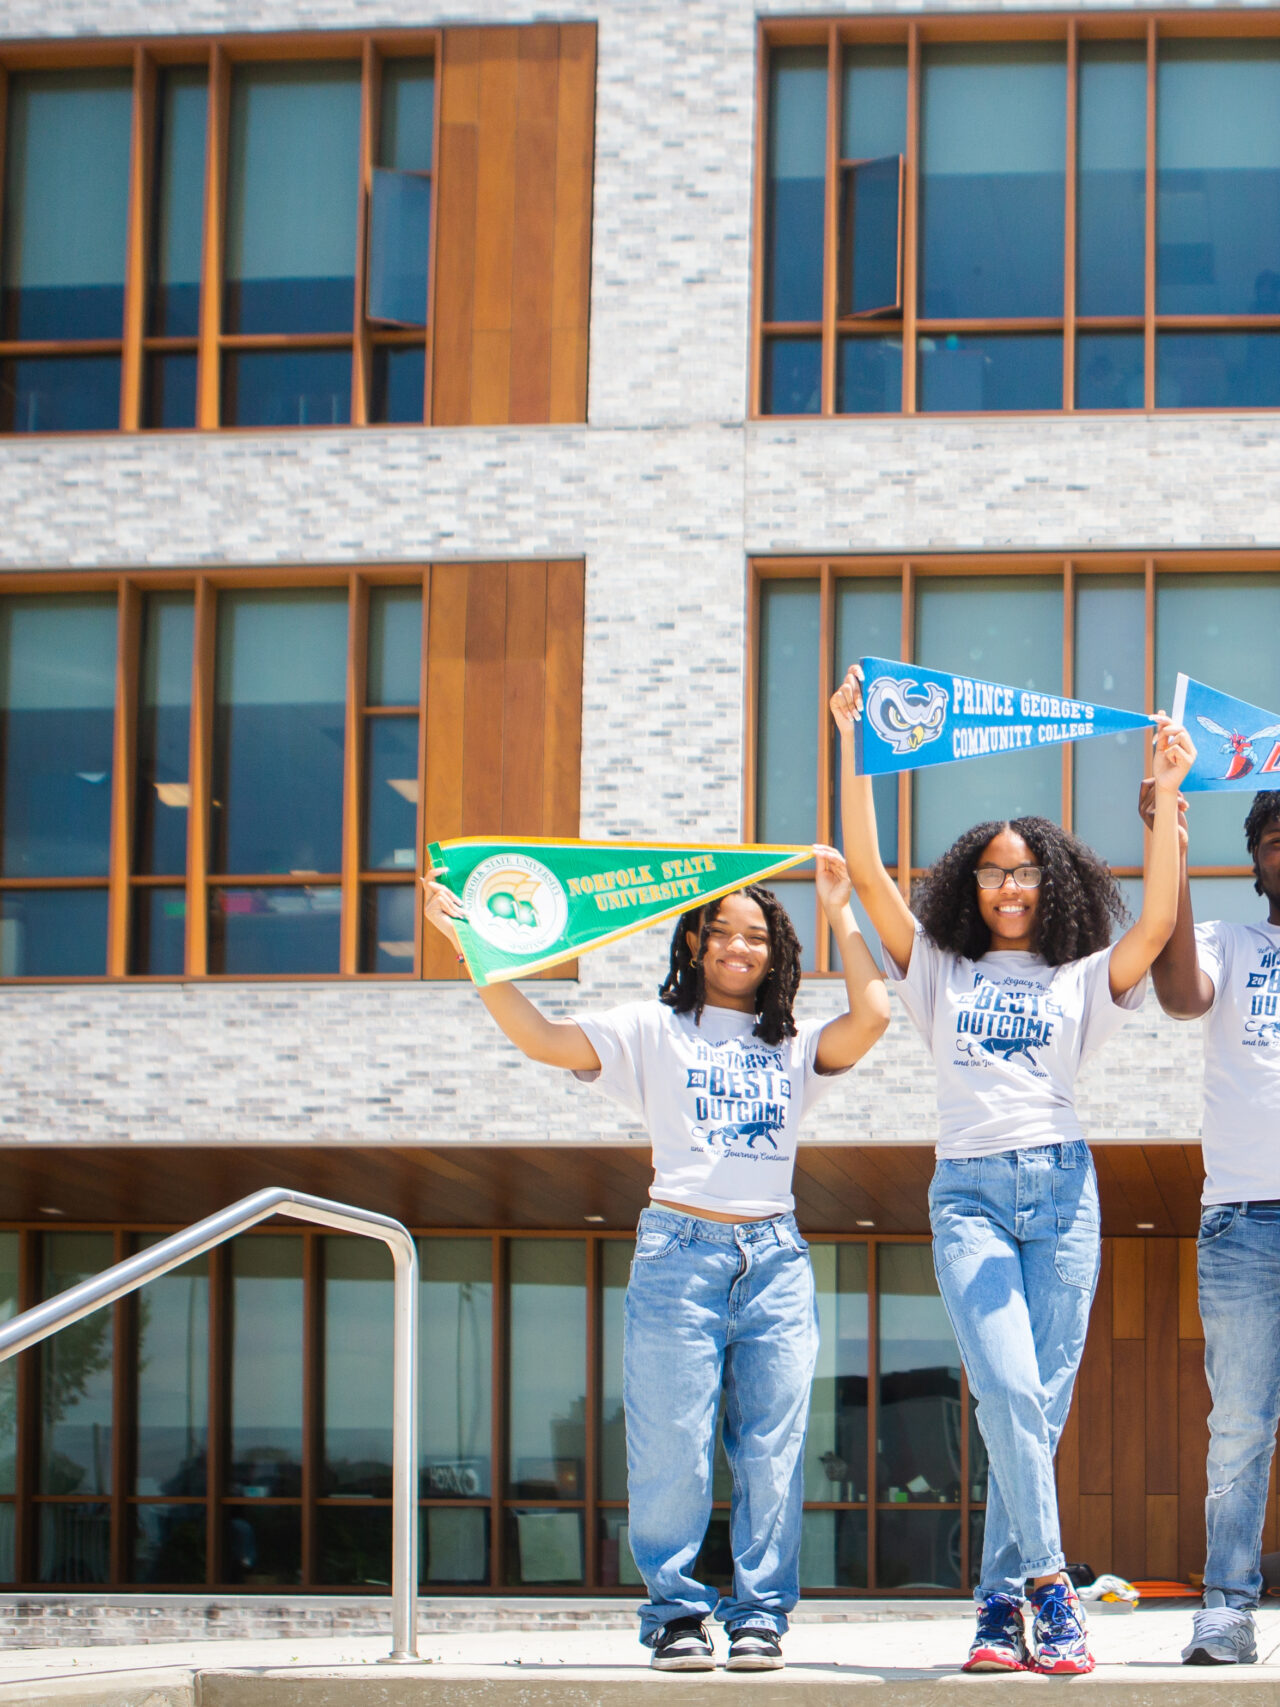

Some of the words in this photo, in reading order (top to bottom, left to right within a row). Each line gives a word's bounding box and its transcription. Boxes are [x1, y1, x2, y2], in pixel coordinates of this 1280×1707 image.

[952, 677, 1014, 717] PRINCE
[1020, 692, 1095, 719] GEORGE'S
[953, 725, 1032, 758] COMMUNITY
[1038, 722, 1094, 742] COLLEGE
[566, 865, 655, 897] NORFOLK
[661, 854, 716, 880] STATE
[594, 876, 700, 912] UNIVERSITY
[1003, 976, 1034, 989] Legacy
[1251, 976, 1265, 985] 20
[956, 1010, 1054, 1046] OUTCOME
[1258, 1039, 1270, 1047] the
[697, 1046, 784, 1072] HISTORY'S
[953, 1059, 969, 1067] and
[691, 1072, 704, 1085] 20
[709, 1066, 775, 1100] BEST
[696, 1097, 786, 1127] OUTCOME
[723, 1149, 759, 1161] Journey
